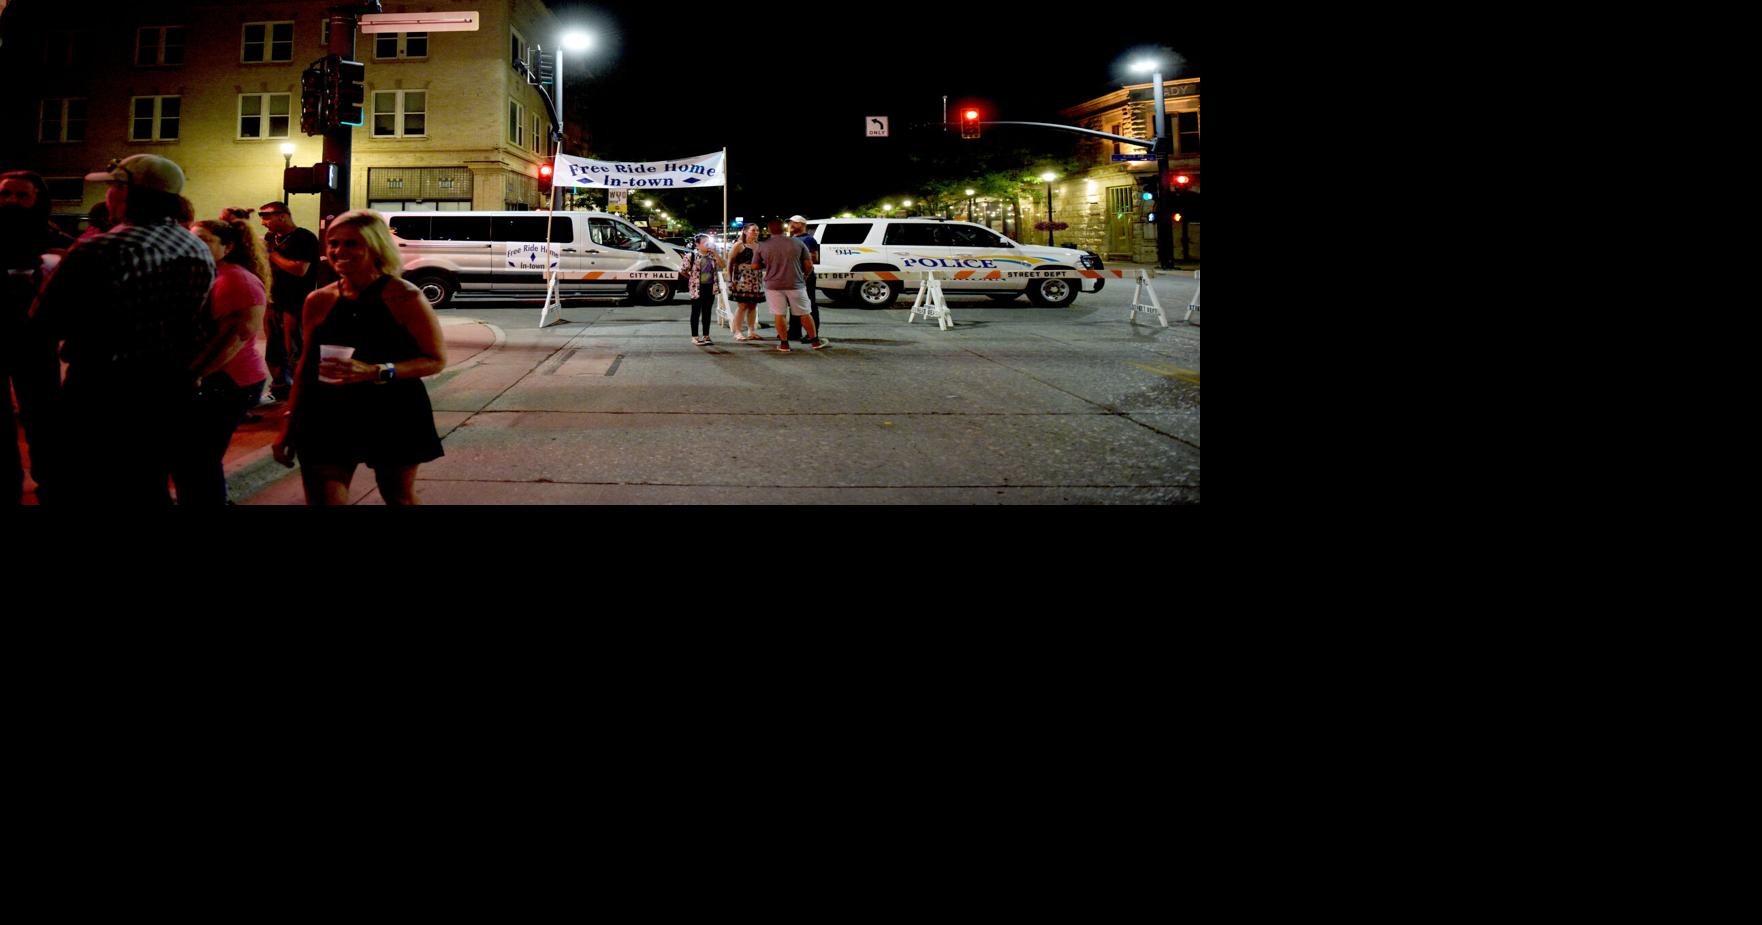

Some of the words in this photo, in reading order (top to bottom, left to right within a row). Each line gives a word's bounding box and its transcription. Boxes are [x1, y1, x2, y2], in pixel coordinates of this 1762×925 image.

[1164, 85, 1188, 96] ADY
[569, 163, 609, 176] Free
[615, 164, 656, 173] Ride
[664, 162, 716, 177] Home
[604, 175, 674, 187] In-town
[507, 247, 521, 258] Free
[523, 244, 539, 252] Ride
[520, 262, 545, 270] In-town
[903, 257, 998, 269] POLICE
